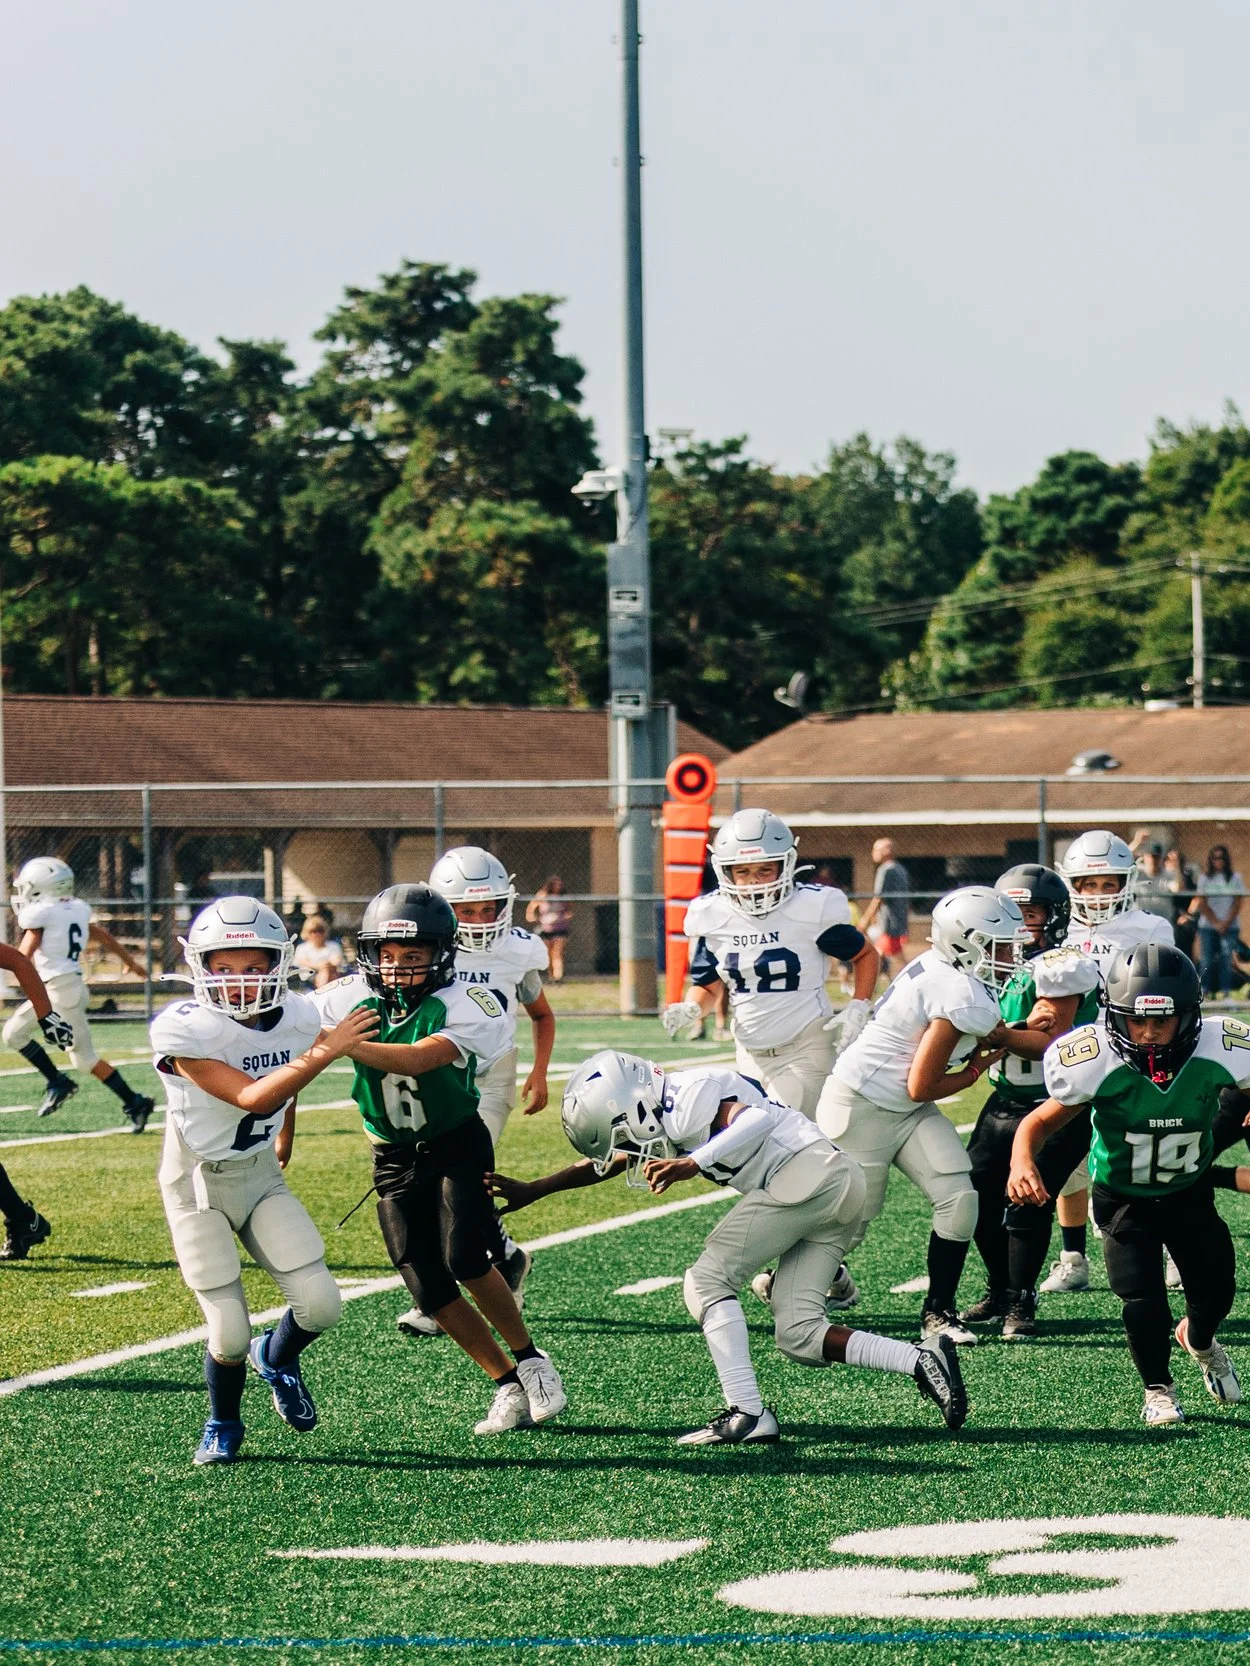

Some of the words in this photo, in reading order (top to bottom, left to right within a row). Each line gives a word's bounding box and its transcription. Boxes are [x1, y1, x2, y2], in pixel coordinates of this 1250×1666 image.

[226, 932, 255, 940] Riddell
[733, 931, 780, 948] SQUAN
[1065, 944, 1112, 955] SQAN
[454, 971, 491, 984] UAN
[722, 947, 802, 994] 18
[466, 986, 502, 1018] 6
[243, 1050, 291, 1072] SQUAN
[381, 1072, 428, 1134] 6
[1148, 1118, 1183, 1128] BRICK
[1124, 1131, 1203, 1185] 19
